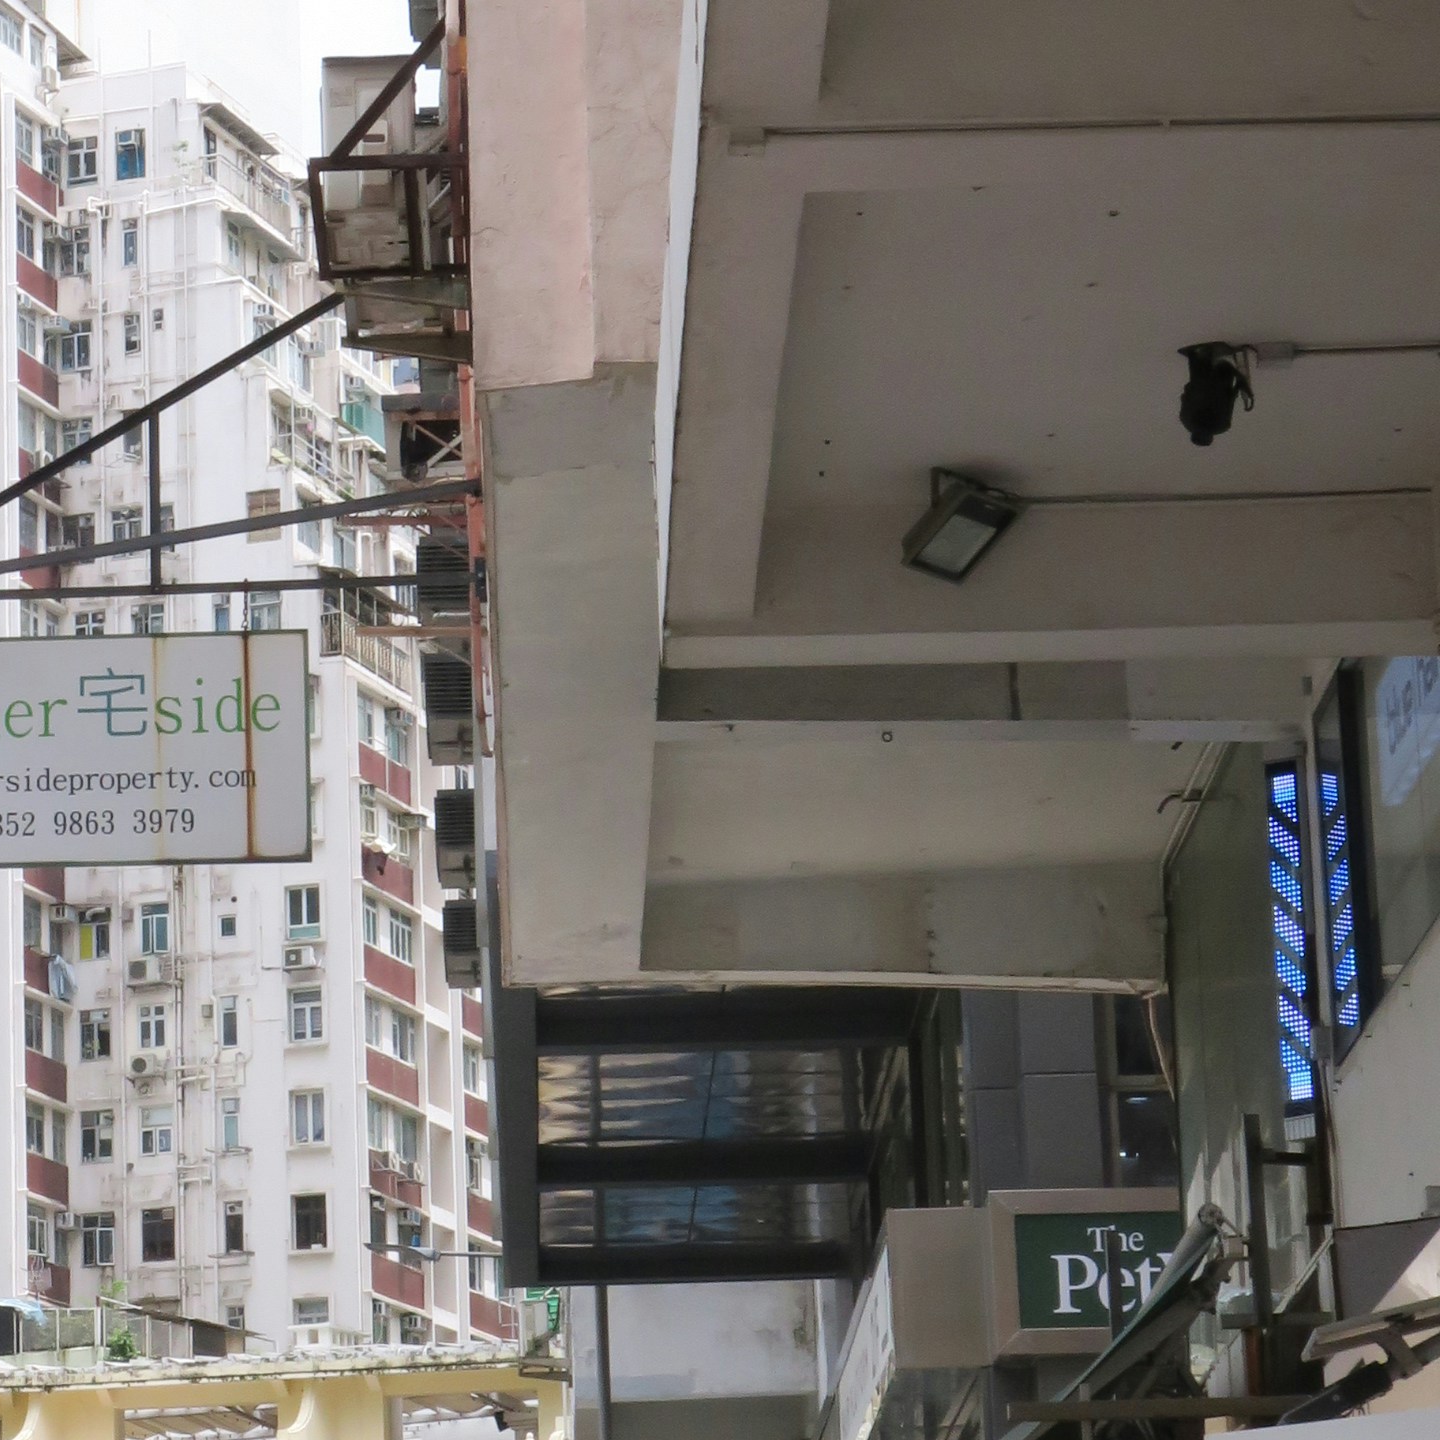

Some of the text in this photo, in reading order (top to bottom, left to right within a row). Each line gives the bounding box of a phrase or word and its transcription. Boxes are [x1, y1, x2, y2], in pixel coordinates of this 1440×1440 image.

[54, 809, 115, 836] 9863
[133, 808, 195, 835] 3979
[1050, 1252, 1174, 1314] Pet
